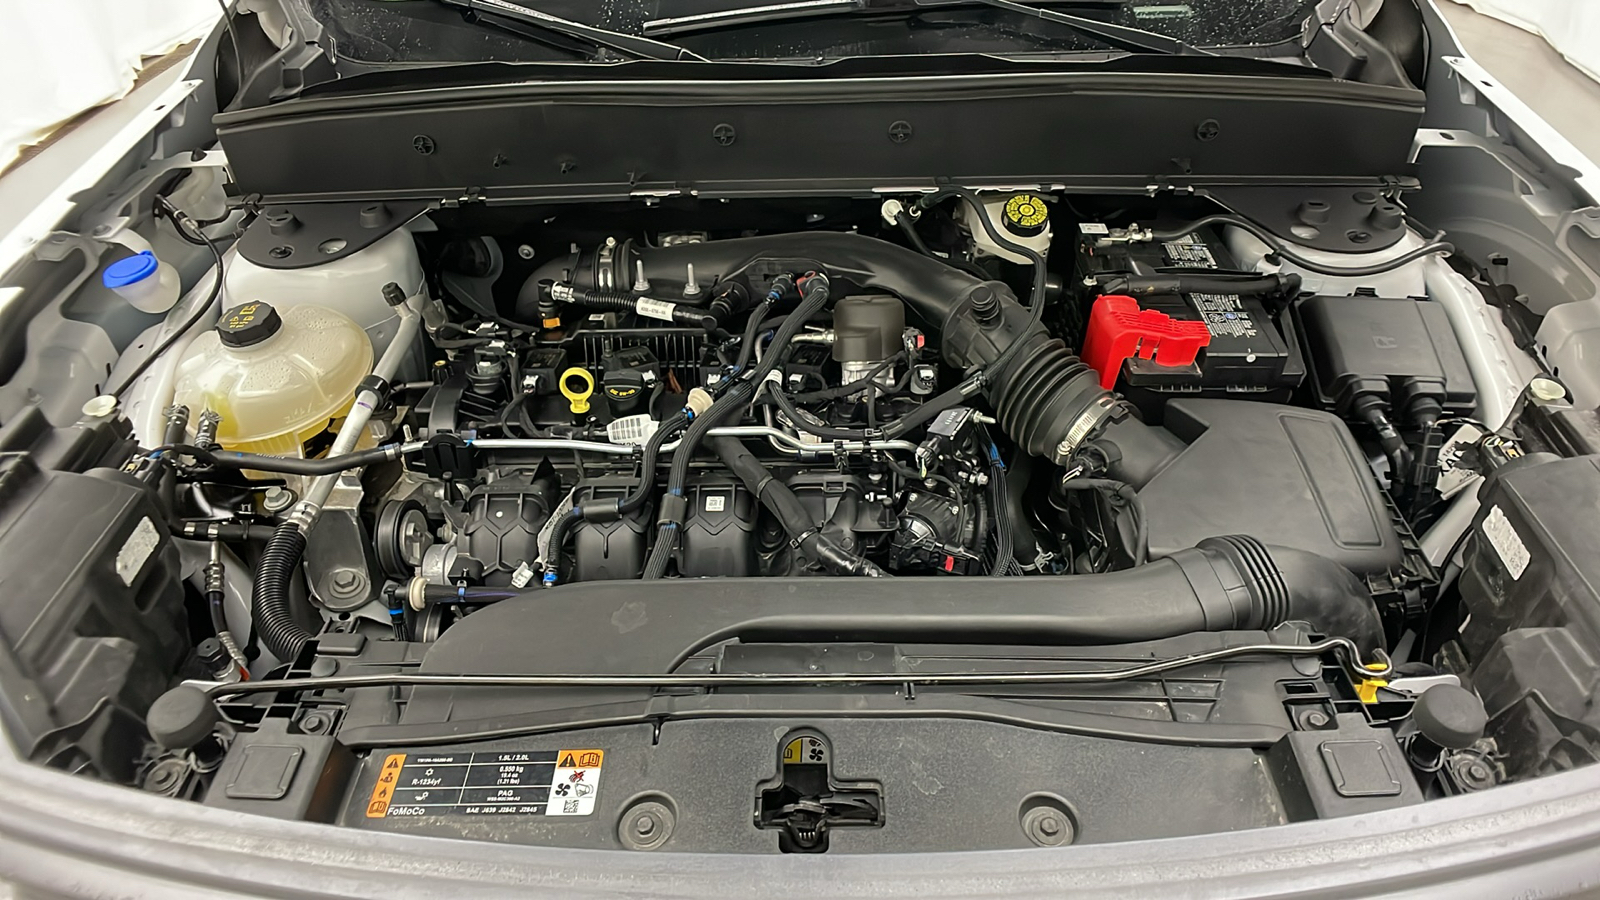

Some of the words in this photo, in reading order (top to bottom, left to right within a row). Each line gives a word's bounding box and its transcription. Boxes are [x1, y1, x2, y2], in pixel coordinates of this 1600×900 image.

[516, 765, 524, 773] kg
[411, 778, 442, 787] R-1234yf
[387, 807, 425, 816] FoMoCo
